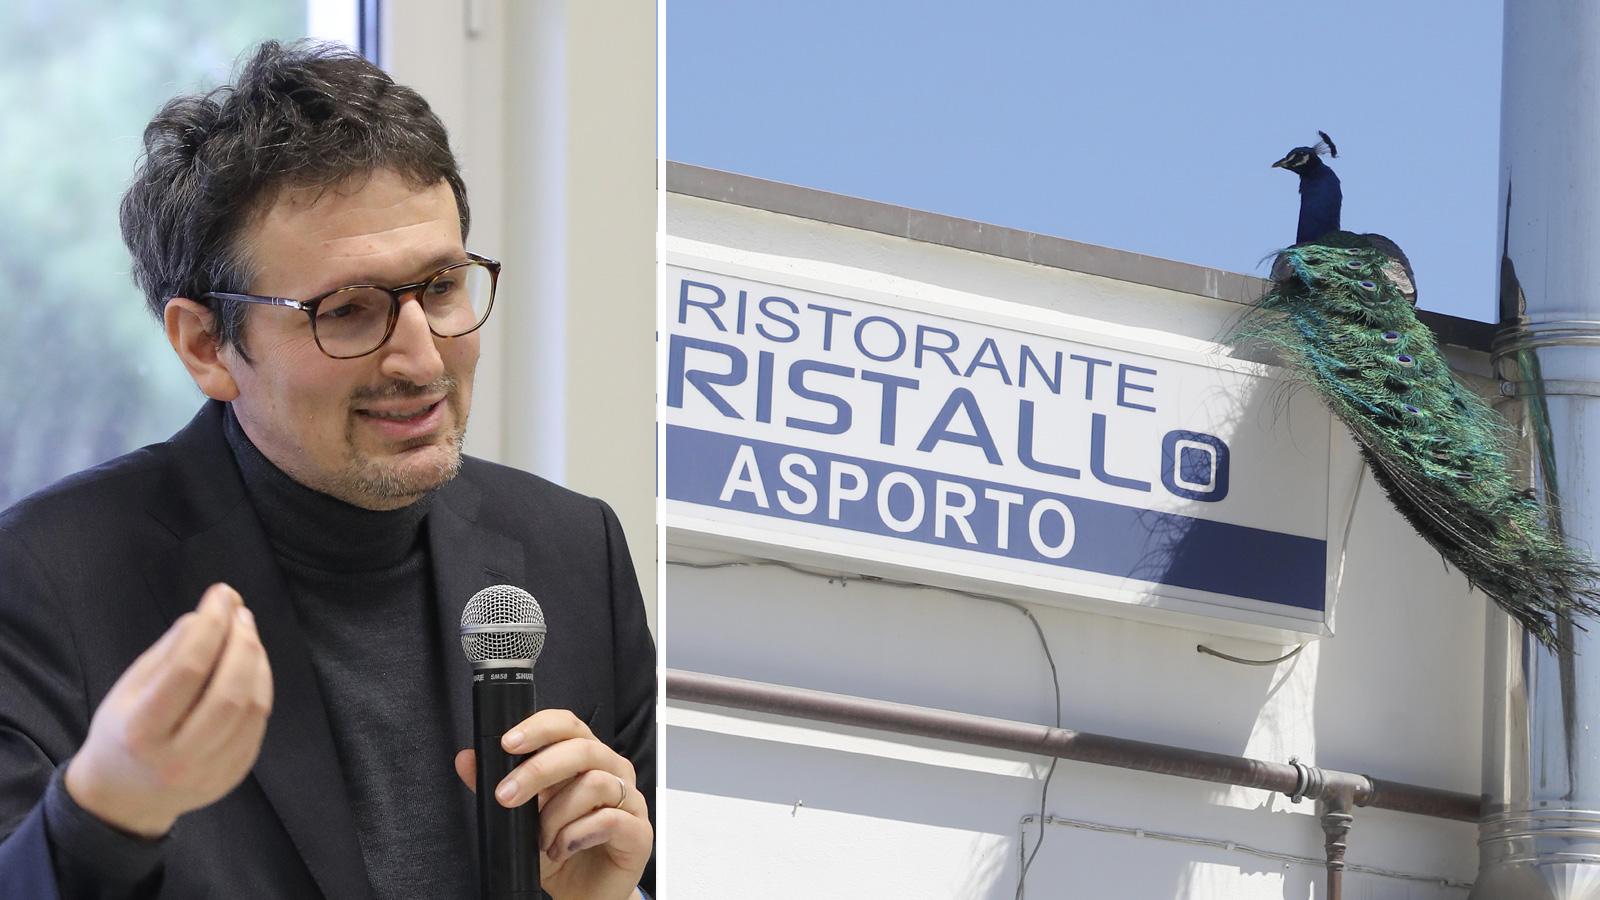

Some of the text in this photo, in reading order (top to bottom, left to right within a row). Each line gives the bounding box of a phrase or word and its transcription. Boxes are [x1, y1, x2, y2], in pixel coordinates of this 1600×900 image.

[678, 279, 1157, 412] RISTORANTE
[656, 331, 1230, 503] RISTALLO
[719, 444, 1076, 559] ASPORTO
